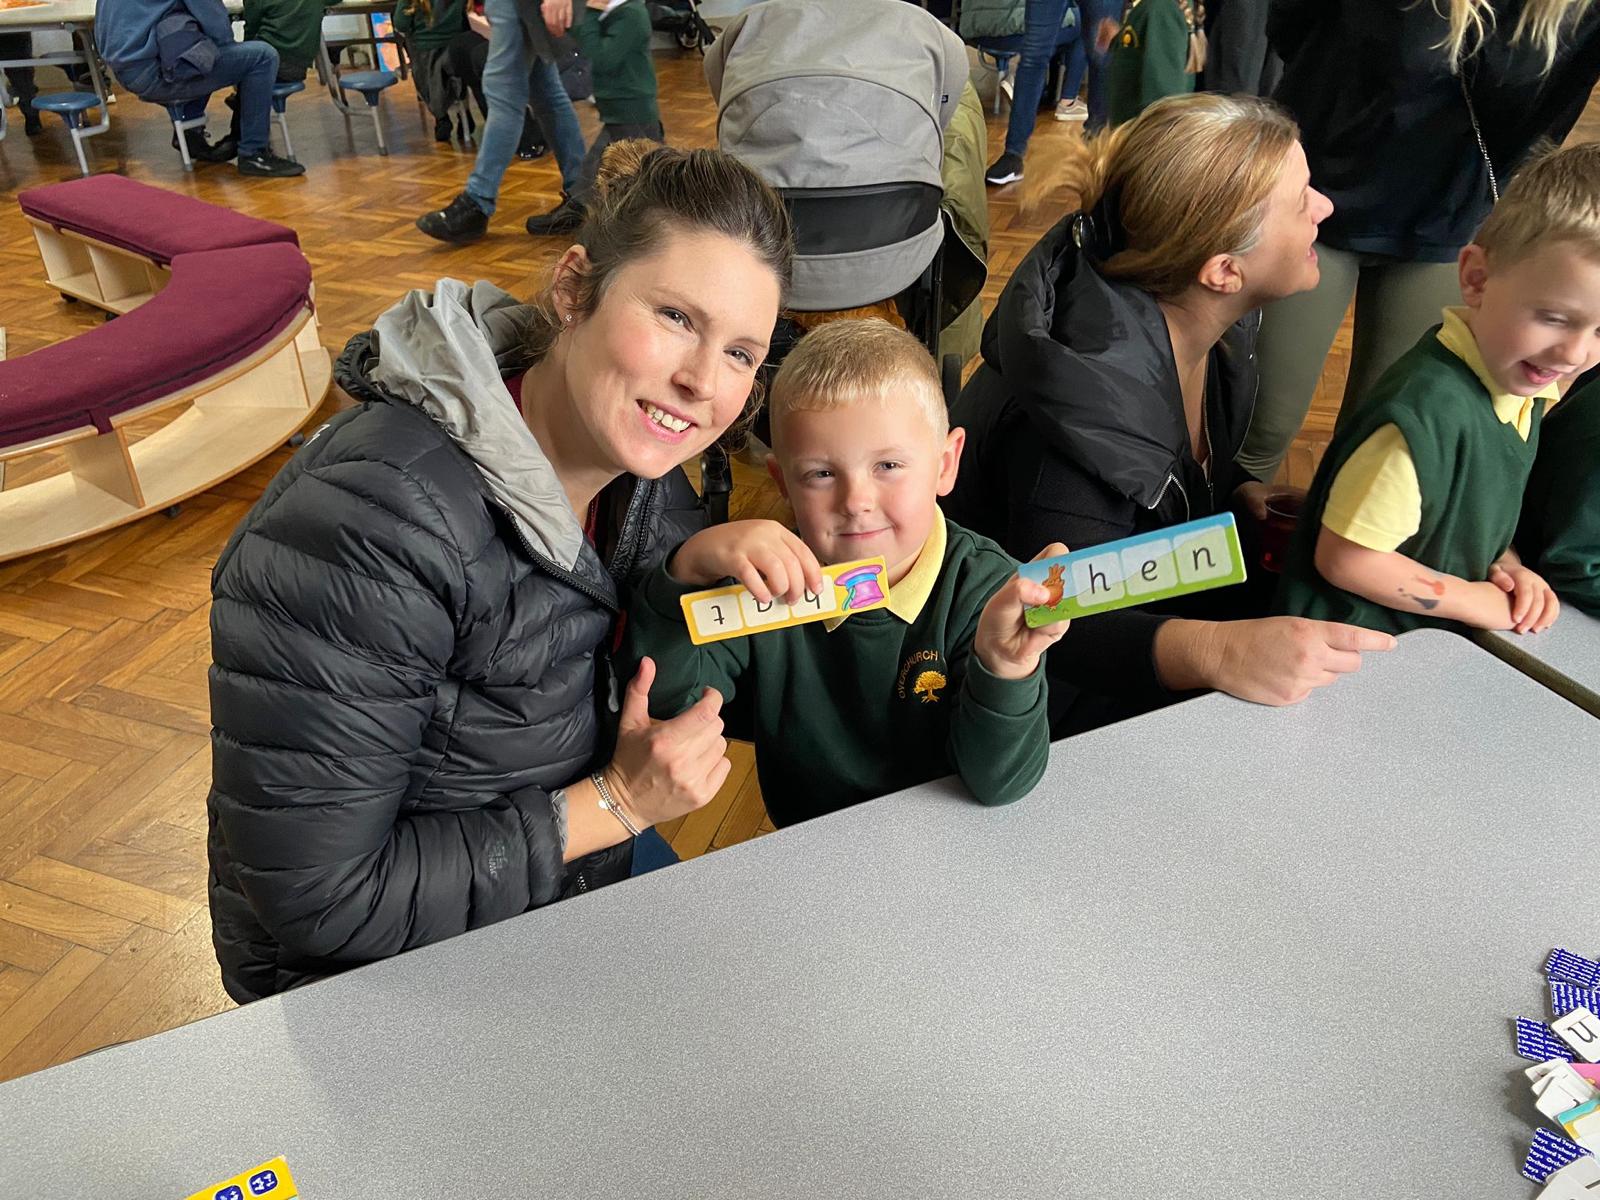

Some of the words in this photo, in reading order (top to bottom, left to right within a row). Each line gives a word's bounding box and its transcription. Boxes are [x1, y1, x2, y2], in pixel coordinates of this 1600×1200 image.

[897, 650, 938, 699] OVERCHURCH
[1534, 1135, 1549, 1145] Toys
[1551, 1143, 1576, 1158] Orchard
[1536, 1127, 1562, 1142] Orchard
[1561, 1140, 1576, 1150] Toys
[1528, 1148, 1544, 1159] Toys
[1531, 1141, 1557, 1157] Orchard
[1527, 1156, 1552, 1171] Orchard
